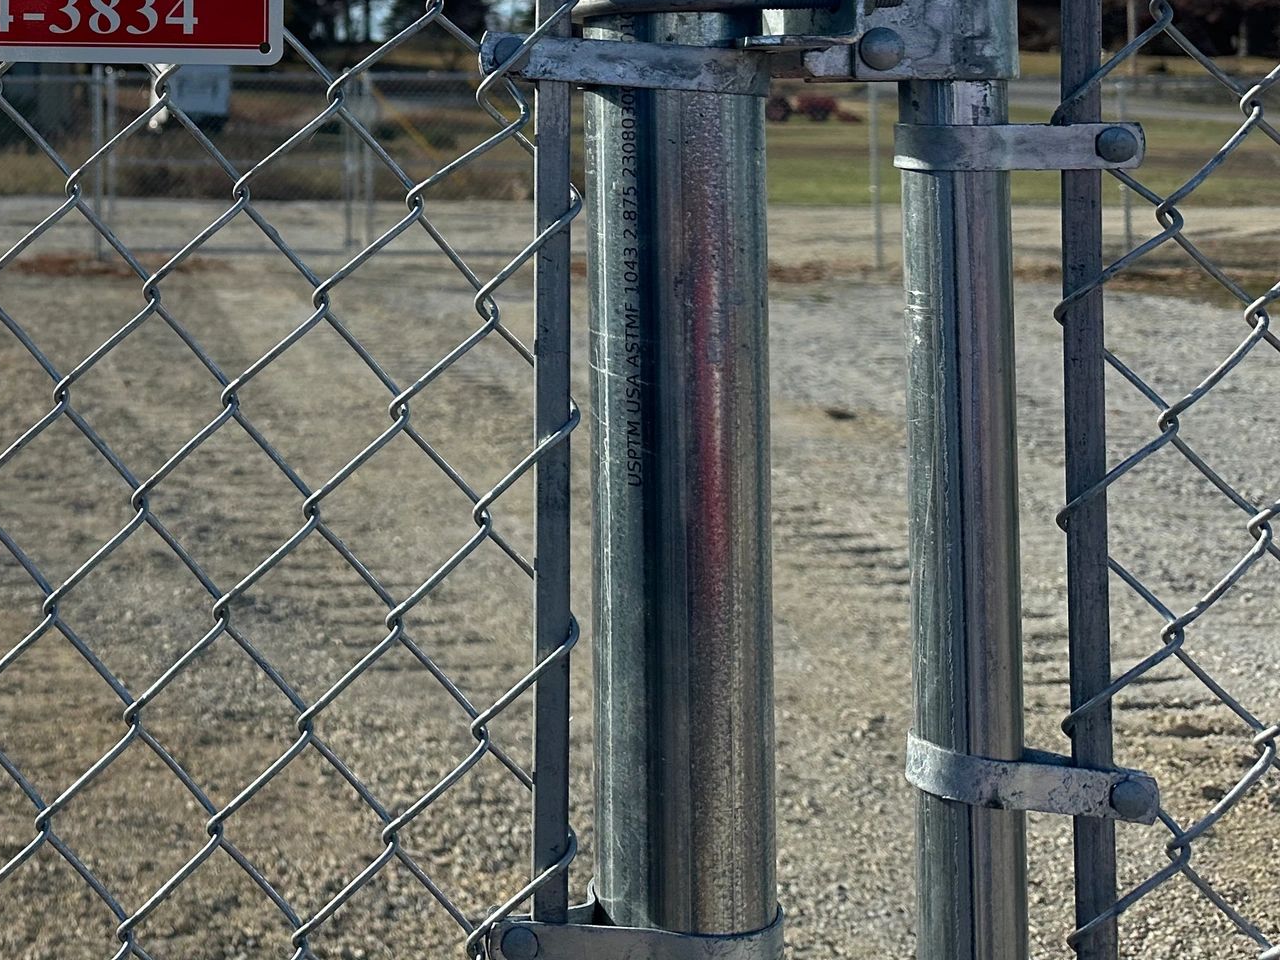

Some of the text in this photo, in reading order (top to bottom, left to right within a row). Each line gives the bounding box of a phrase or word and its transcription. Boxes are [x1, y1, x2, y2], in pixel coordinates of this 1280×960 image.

[622, 186, 638, 240] 2.875
[623, 247, 640, 294] 1043
[624, 302, 641, 368] ASTMF
[625, 373, 642, 414] USA
[626, 420, 643, 487] USPTM
